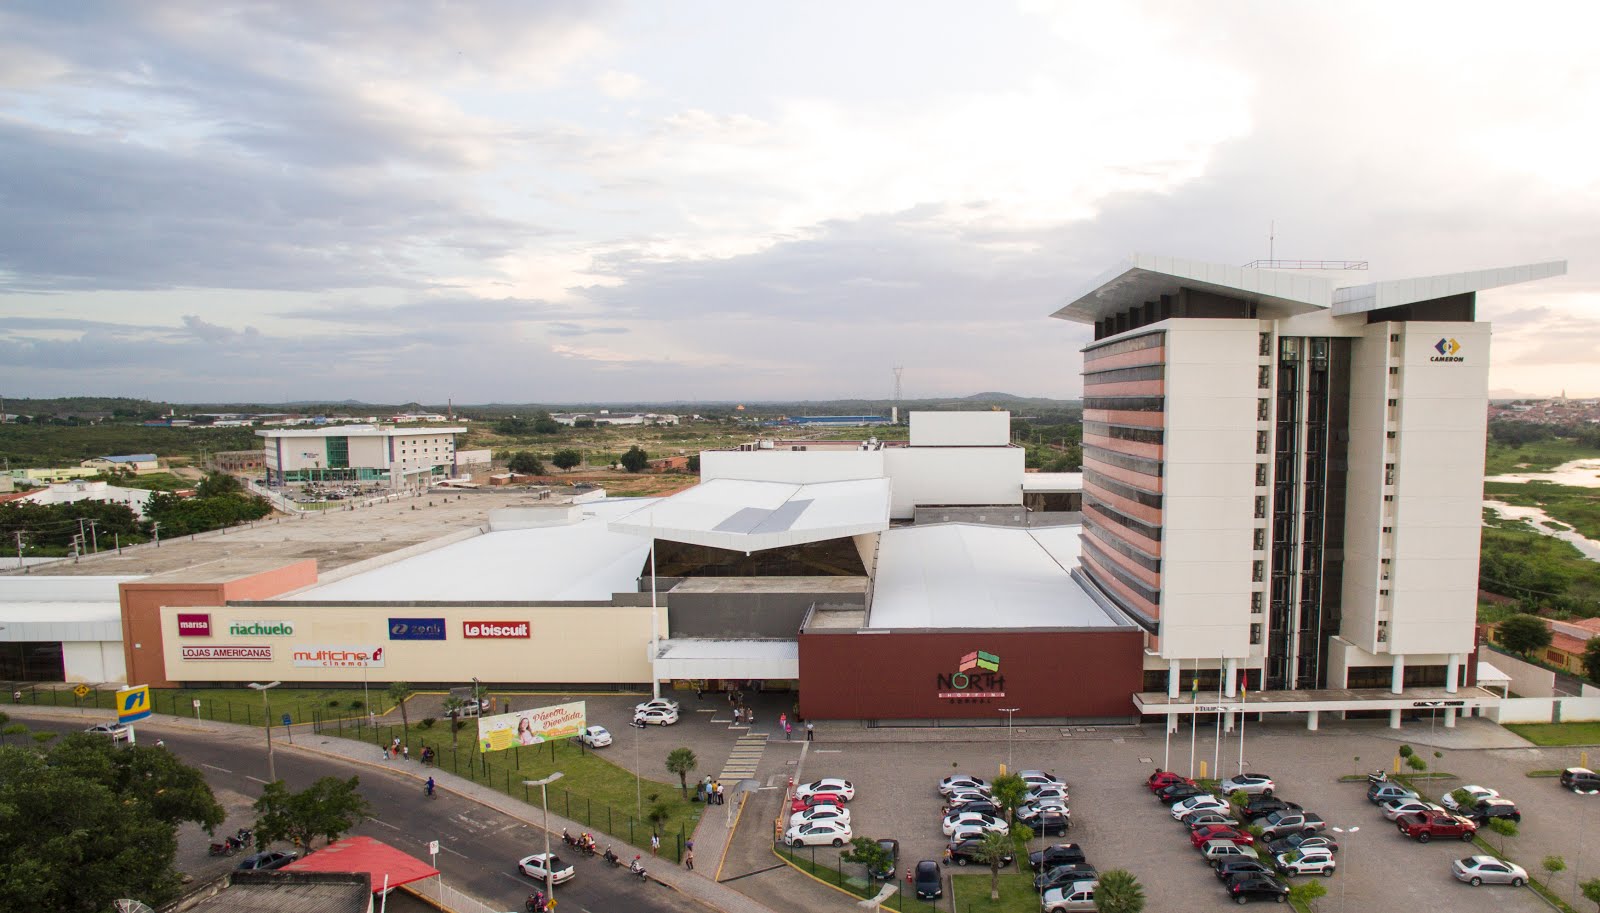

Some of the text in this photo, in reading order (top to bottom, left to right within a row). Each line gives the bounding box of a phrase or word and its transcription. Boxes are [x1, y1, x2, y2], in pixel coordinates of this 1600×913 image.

[180, 621, 208, 629] marisa
[230, 622, 293, 635] riachuelo
[465, 624, 528, 636] Le biscuit
[182, 649, 271, 657] LOJAS AMERICANAS
[293, 650, 368, 661] multicine
[937, 671, 1005, 691] NORTH
